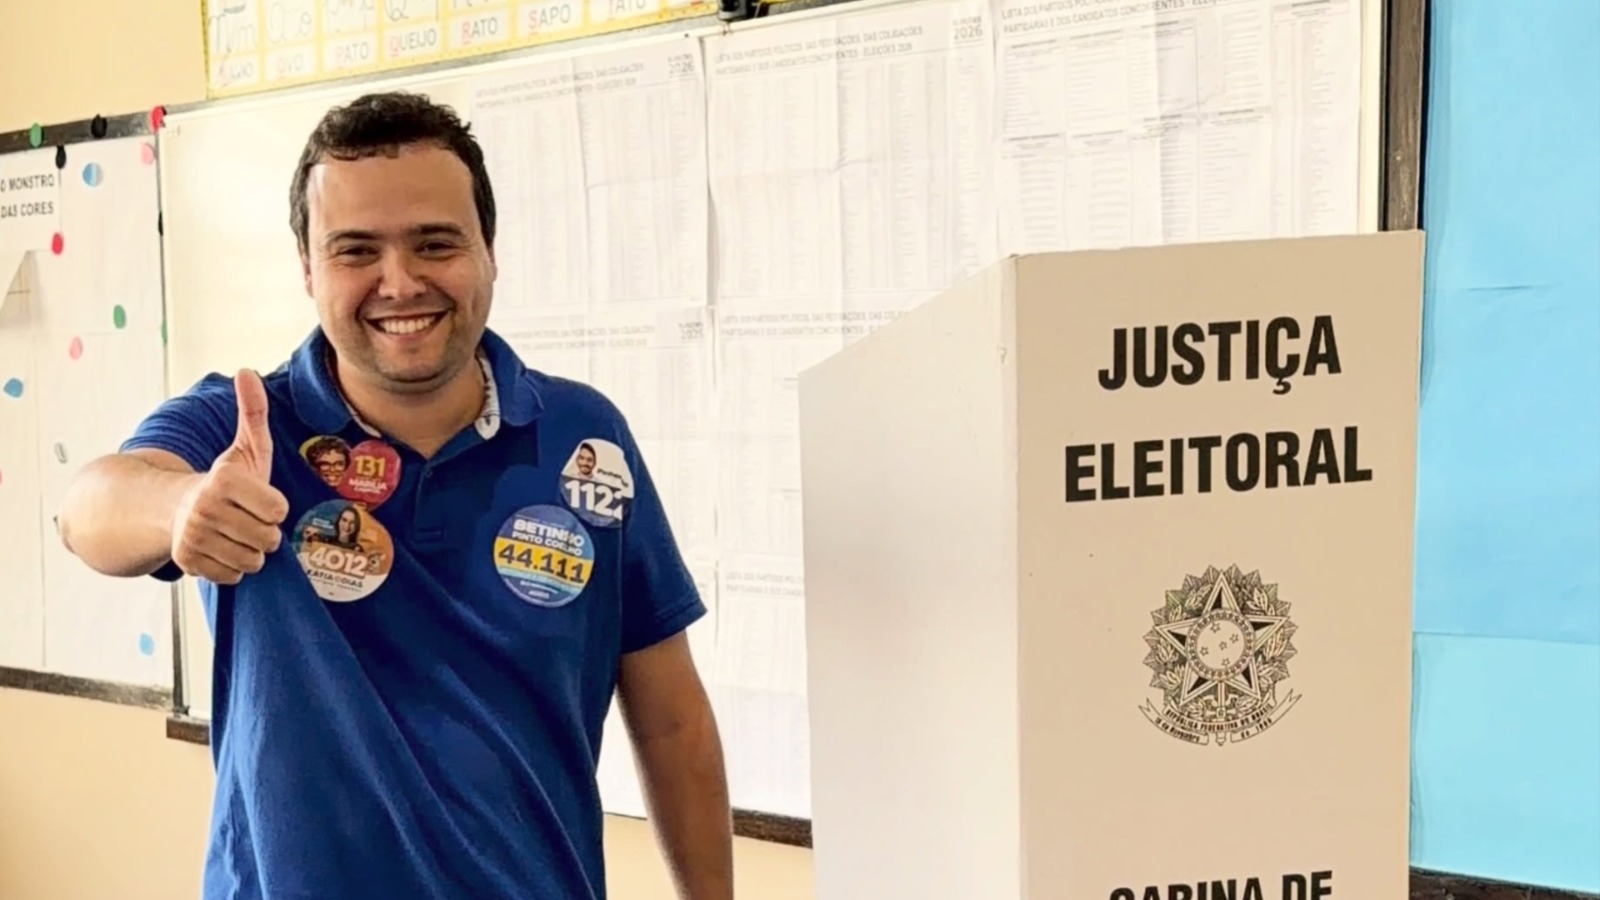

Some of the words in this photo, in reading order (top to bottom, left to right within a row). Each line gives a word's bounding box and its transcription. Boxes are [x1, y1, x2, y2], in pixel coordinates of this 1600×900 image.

[462, 16, 498, 40] RATO
[528, 3, 571, 30] SAPO
[388, 27, 438, 54] QUEIJO
[953, 24, 983, 40] 2026
[8, 173, 55, 191] MONSTRO
[0, 204, 17, 219] DAS
[20, 201, 54, 217] CORES
[1098, 315, 1342, 395] JUSTIÇA
[355, 454, 387, 477] 131
[1065, 425, 1373, 503] ELEITORAL
[511, 530, 543, 544] PINTO
[309, 545, 369, 577] 4012
[498, 543, 585, 584] 44.111
[1282, 870, 1333, 900] DE
